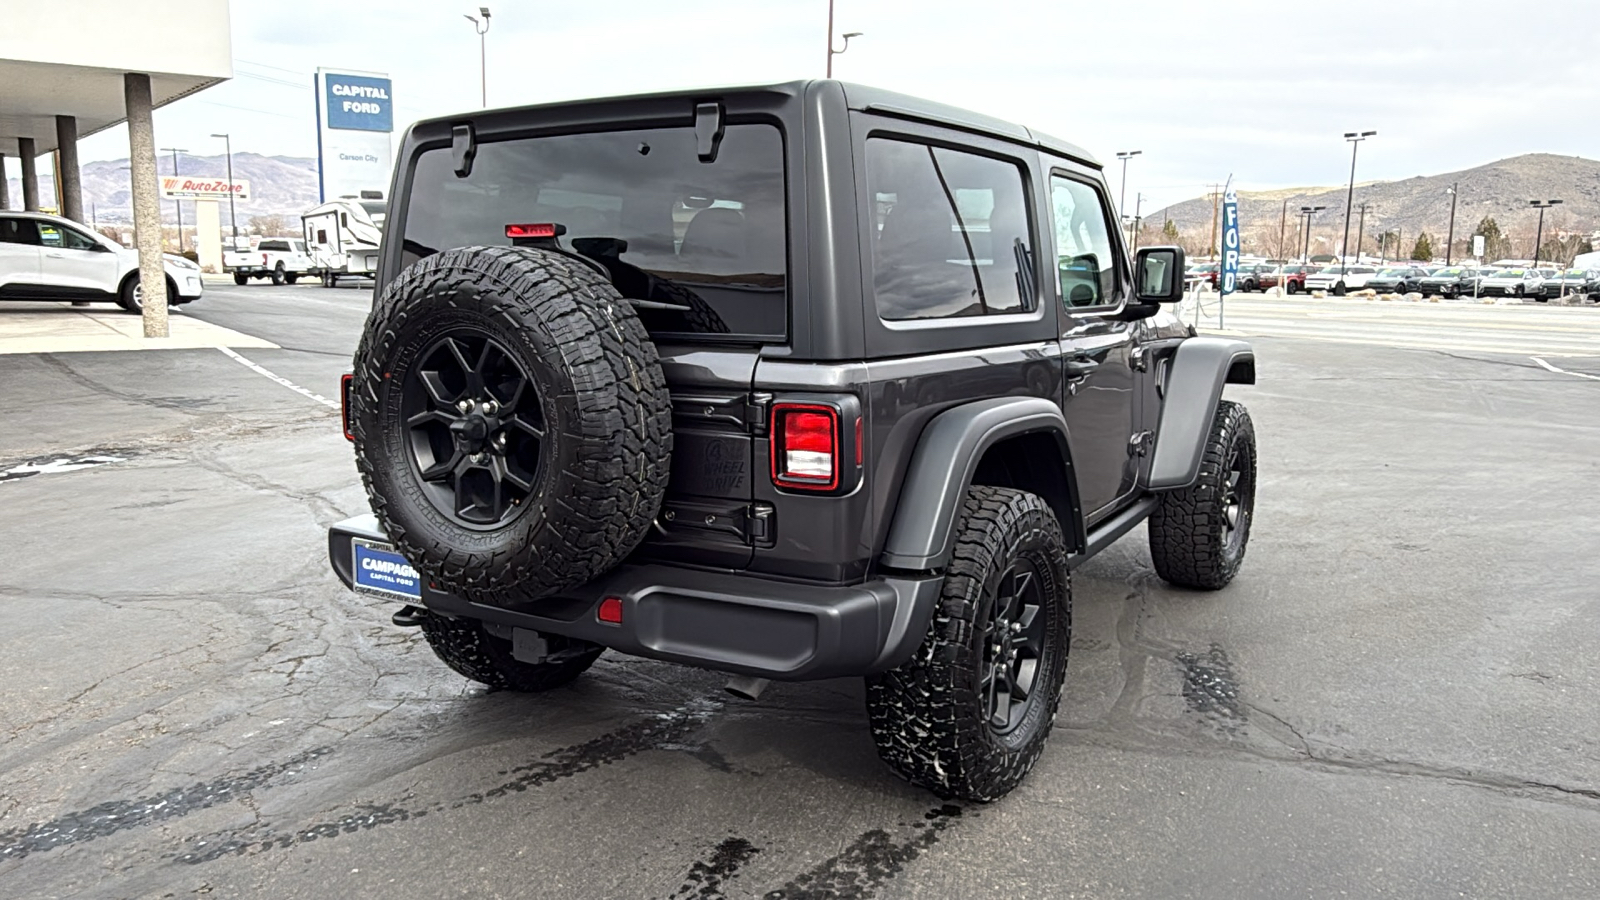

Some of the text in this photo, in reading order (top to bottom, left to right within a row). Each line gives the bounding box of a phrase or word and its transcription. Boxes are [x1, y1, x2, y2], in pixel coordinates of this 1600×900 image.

[332, 84, 389, 99] CAPITAL
[343, 101, 381, 115] FORD
[339, 153, 379, 163] Carson City
[1224, 206, 1238, 292] FORD
[370, 572, 414, 587] CAPITAL FORD
